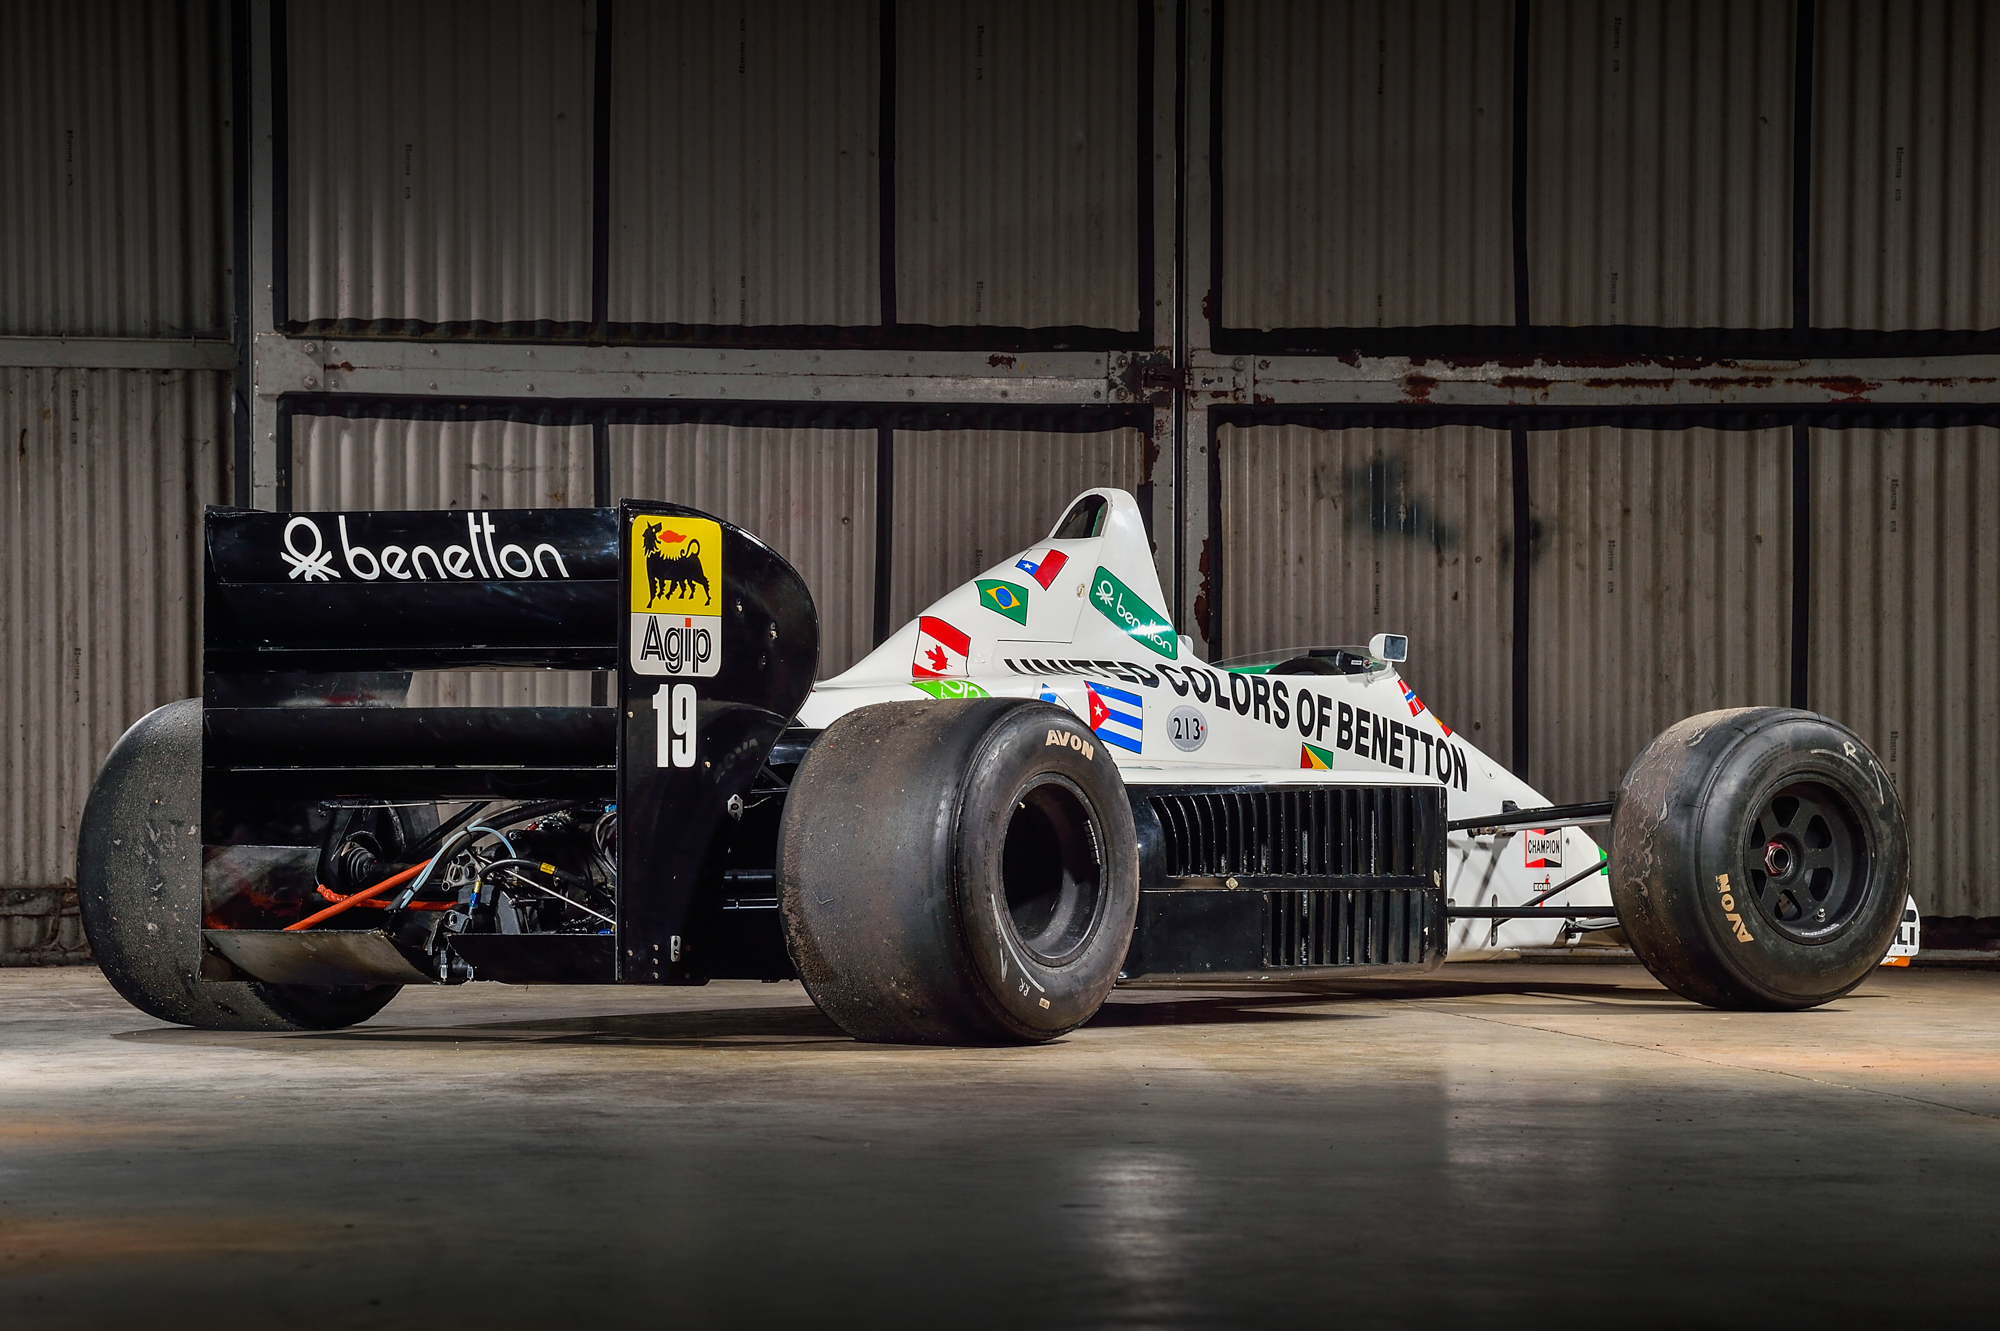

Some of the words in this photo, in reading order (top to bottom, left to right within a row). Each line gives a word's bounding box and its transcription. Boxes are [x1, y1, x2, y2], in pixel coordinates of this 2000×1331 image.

[338, 511, 570, 581] benetton
[639, 615, 712, 674] Agip
[1116, 592, 1172, 653] bentton
[652, 683, 697, 768] 19
[1003, 658, 1160, 688] UNITED
[1154, 663, 1291, 730] COLORS
[1296, 688, 1333, 742] OF
[1336, 700, 1468, 793] BENETTON
[1045, 729, 1094, 761] AVON
[1173, 717, 1201, 741] 213
[1527, 839, 1560, 854] CHAMPION
[1534, 883, 1550, 891] KONI
[1715, 873, 1755, 943] AVON
